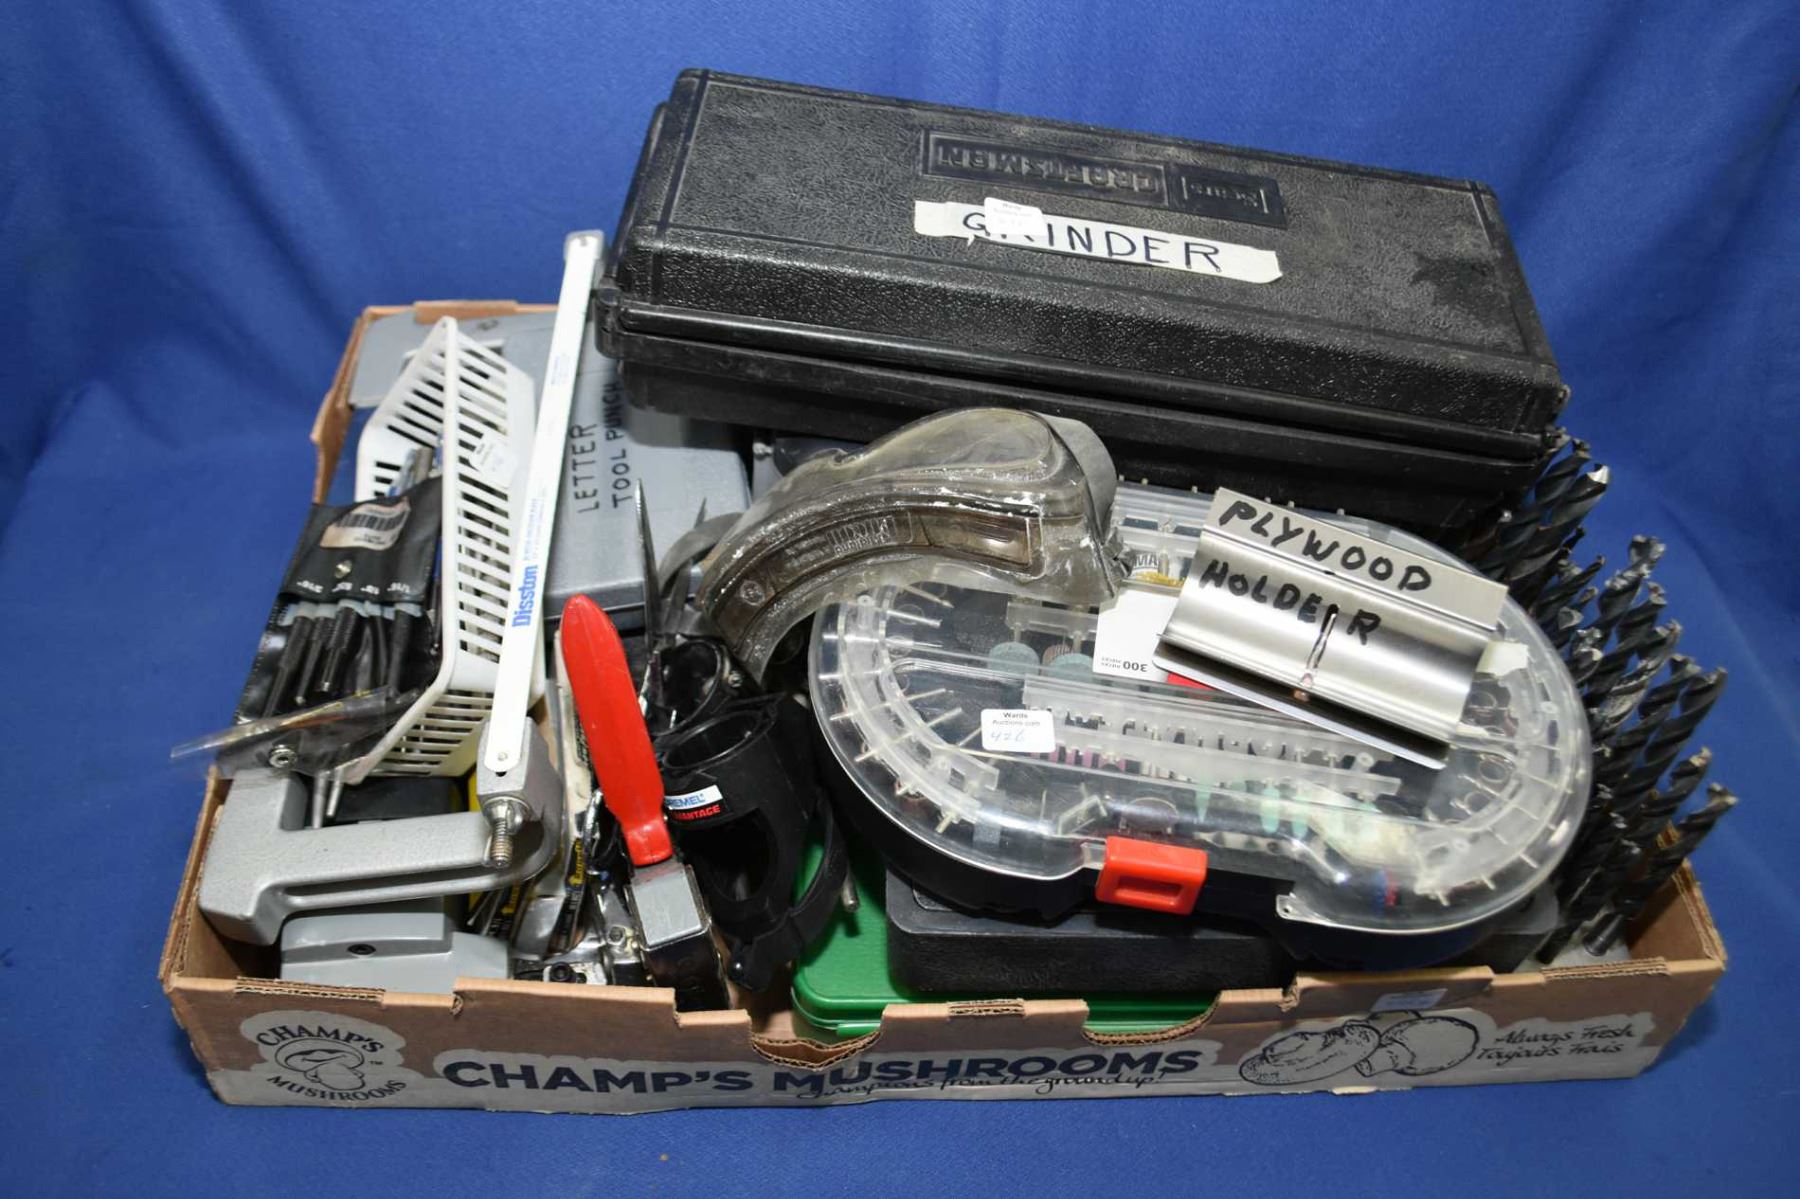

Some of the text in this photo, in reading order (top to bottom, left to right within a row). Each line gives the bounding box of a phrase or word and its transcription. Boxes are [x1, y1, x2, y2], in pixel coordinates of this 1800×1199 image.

[961, 210, 1223, 273] GINDER
[569, 422, 601, 515] LETTER
[601, 381, 634, 510] TOOL PUNCH
[1217, 500, 1433, 593] PLYWOOD
[511, 564, 539, 628] Disston
[1199, 559, 1383, 646] HOLDER
[1122, 660, 1148, 673] 300
[1003, 711, 1029, 719] Wards
[256, 1025, 385, 1053] CHAMP'S
[1494, 1023, 1636, 1045] Always Fresh
[266, 1075, 407, 1101] MUSHROOMS
[443, 1050, 1203, 1095] CHAMP'S MUSHROOMS
